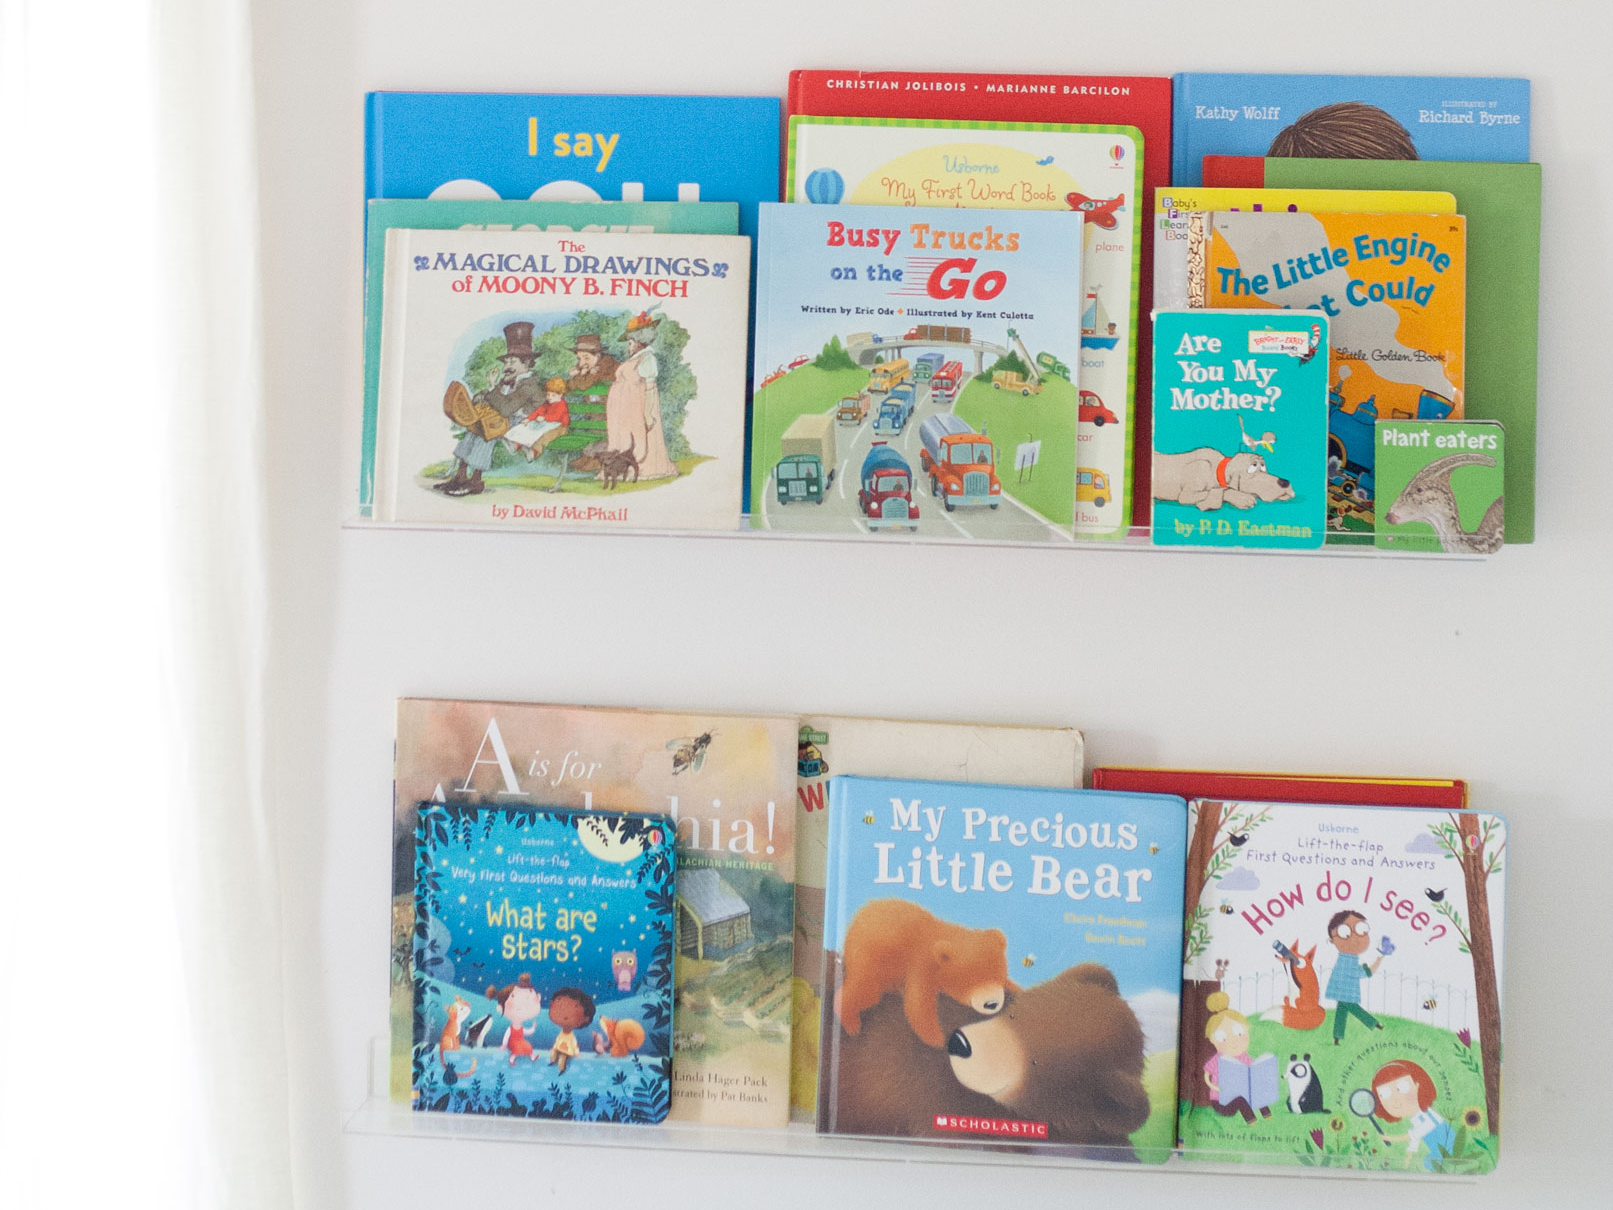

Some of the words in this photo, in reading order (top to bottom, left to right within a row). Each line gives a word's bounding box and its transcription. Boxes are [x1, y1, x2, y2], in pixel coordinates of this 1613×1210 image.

[827, 79, 899, 91] CHRISTIAN
[905, 81, 967, 93] JOLIBOIS
[986, 83, 1057, 95] MARIANNE
[1063, 85, 1131, 97] BARCILON
[1195, 105, 1239, 122] Kathy
[1242, 106, 1281, 120] Wolff
[1418, 109, 1475, 124] Richard
[1479, 111, 1521, 127] Byrne
[528, 117, 538, 156] I
[553, 133, 620, 172] say
[943, 154, 1000, 175] Usborne
[881, 176, 916, 206] My
[922, 178, 963, 201] First
[967, 178, 1017, 202] Word
[1020, 180, 1057, 203] Book
[1163, 197, 1198, 210] Baby's
[1168, 209, 1189, 219] Firs
[826, 221, 901, 257] Busy
[909, 222, 1021, 253] Trucks
[1166, 230, 1188, 240] Boo
[558, 239, 587, 254] The
[1095, 241, 1125, 257] plane
[432, 252, 557, 273] MAGICAL
[563, 255, 711, 277] DRAWINGS
[1216, 266, 1269, 296] The
[1272, 246, 1350, 290] Little
[1353, 232, 1451, 274] Engine
[451, 274, 474, 293] of
[477, 275, 576, 295] MOONY
[584, 277, 605, 296] B.
[610, 278, 689, 298] FINCH
[830, 265, 858, 281] on
[866, 262, 904, 282] the
[925, 257, 1008, 301] Go
[1346, 276, 1435, 308] Could
[800, 304, 837, 315] Written
[840, 305, 852, 318] by
[855, 305, 875, 316] Eric
[877, 306, 895, 317] Ode
[906, 307, 958, 318] Illustrated
[961, 308, 973, 320] by
[976, 309, 998, 320] Kent
[1000, 310, 1034, 321] Culotta
[1174, 332, 1222, 356] Are
[1081, 358, 1105, 369] boat
[1335, 347, 1369, 361] Little
[1371, 348, 1412, 362] Golden
[1413, 349, 1446, 362] Book
[1178, 360, 1224, 383] You
[1234, 359, 1278, 388] My
[1170, 387, 1282, 413] Mother?
[1077, 434, 1093, 442] car
[1382, 428, 1430, 447] Plant
[1435, 431, 1497, 450] eaters
[491, 503, 509, 520] by
[512, 504, 557, 519] David
[560, 505, 629, 521] McPhail
[1081, 512, 1099, 523] bus
[1174, 518, 1194, 538] by
[1198, 519, 1213, 535] P.
[1217, 520, 1233, 536] D.
[1237, 520, 1312, 539] Eastman
[455, 717, 530, 796] A
[529, 751, 550, 779] is
[551, 749, 602, 787] for
[890, 797, 946, 842] My
[962, 806, 1139, 851] Precious
[1318, 823, 1360, 835] Usborne
[521, 837, 555, 847] Usborne
[1297, 837, 1384, 855] Lift-the-flap
[507, 852, 570, 870] Lift-the-flap
[725, 859, 774, 871] HERITAGE
[1246, 849, 1278, 863] First
[1282, 851, 1347, 867] Questions
[1351, 854, 1375, 868] and
[1380, 855, 1436, 871] Answers
[450, 865, 476, 884] Very
[479, 868, 506, 882] First
[509, 870, 563, 886] Questions
[567, 873, 587, 886] and
[591, 874, 637, 889] Answers
[873, 842, 1014, 894] Little
[1026, 854, 1153, 904] Bear
[486, 900, 547, 931] What
[555, 907, 598, 933] are
[1241, 883, 1304, 935] How
[1316, 870, 1352, 903] do
[1364, 876, 1374, 903] I
[1379, 890, 1448, 946] see?
[501, 933, 582, 962] Stars?
[673, 1071, 704, 1083] Linda
[708, 1073, 740, 1087] Hager
[743, 1076, 768, 1087] Pack
[1335, 1088, 1345, 1106] And
[1341, 1061, 1356, 1086] other
[1357, 1041, 1398, 1061] questions
[1402, 1042, 1428, 1055] about
[1429, 1054, 1441, 1067] our
[707, 1090, 718, 1102] by
[721, 1091, 736, 1101] Pat
[739, 1092, 768, 1103] Banks
[949, 1118, 1046, 1135] SCHOLASTIC
[1219, 1132, 1234, 1140] lots
[1236, 1133, 1247, 1141] of
[1250, 1133, 1271, 1144] flaps
[1274, 1135, 1283, 1143] to
[1286, 1135, 1300, 1143] lift
